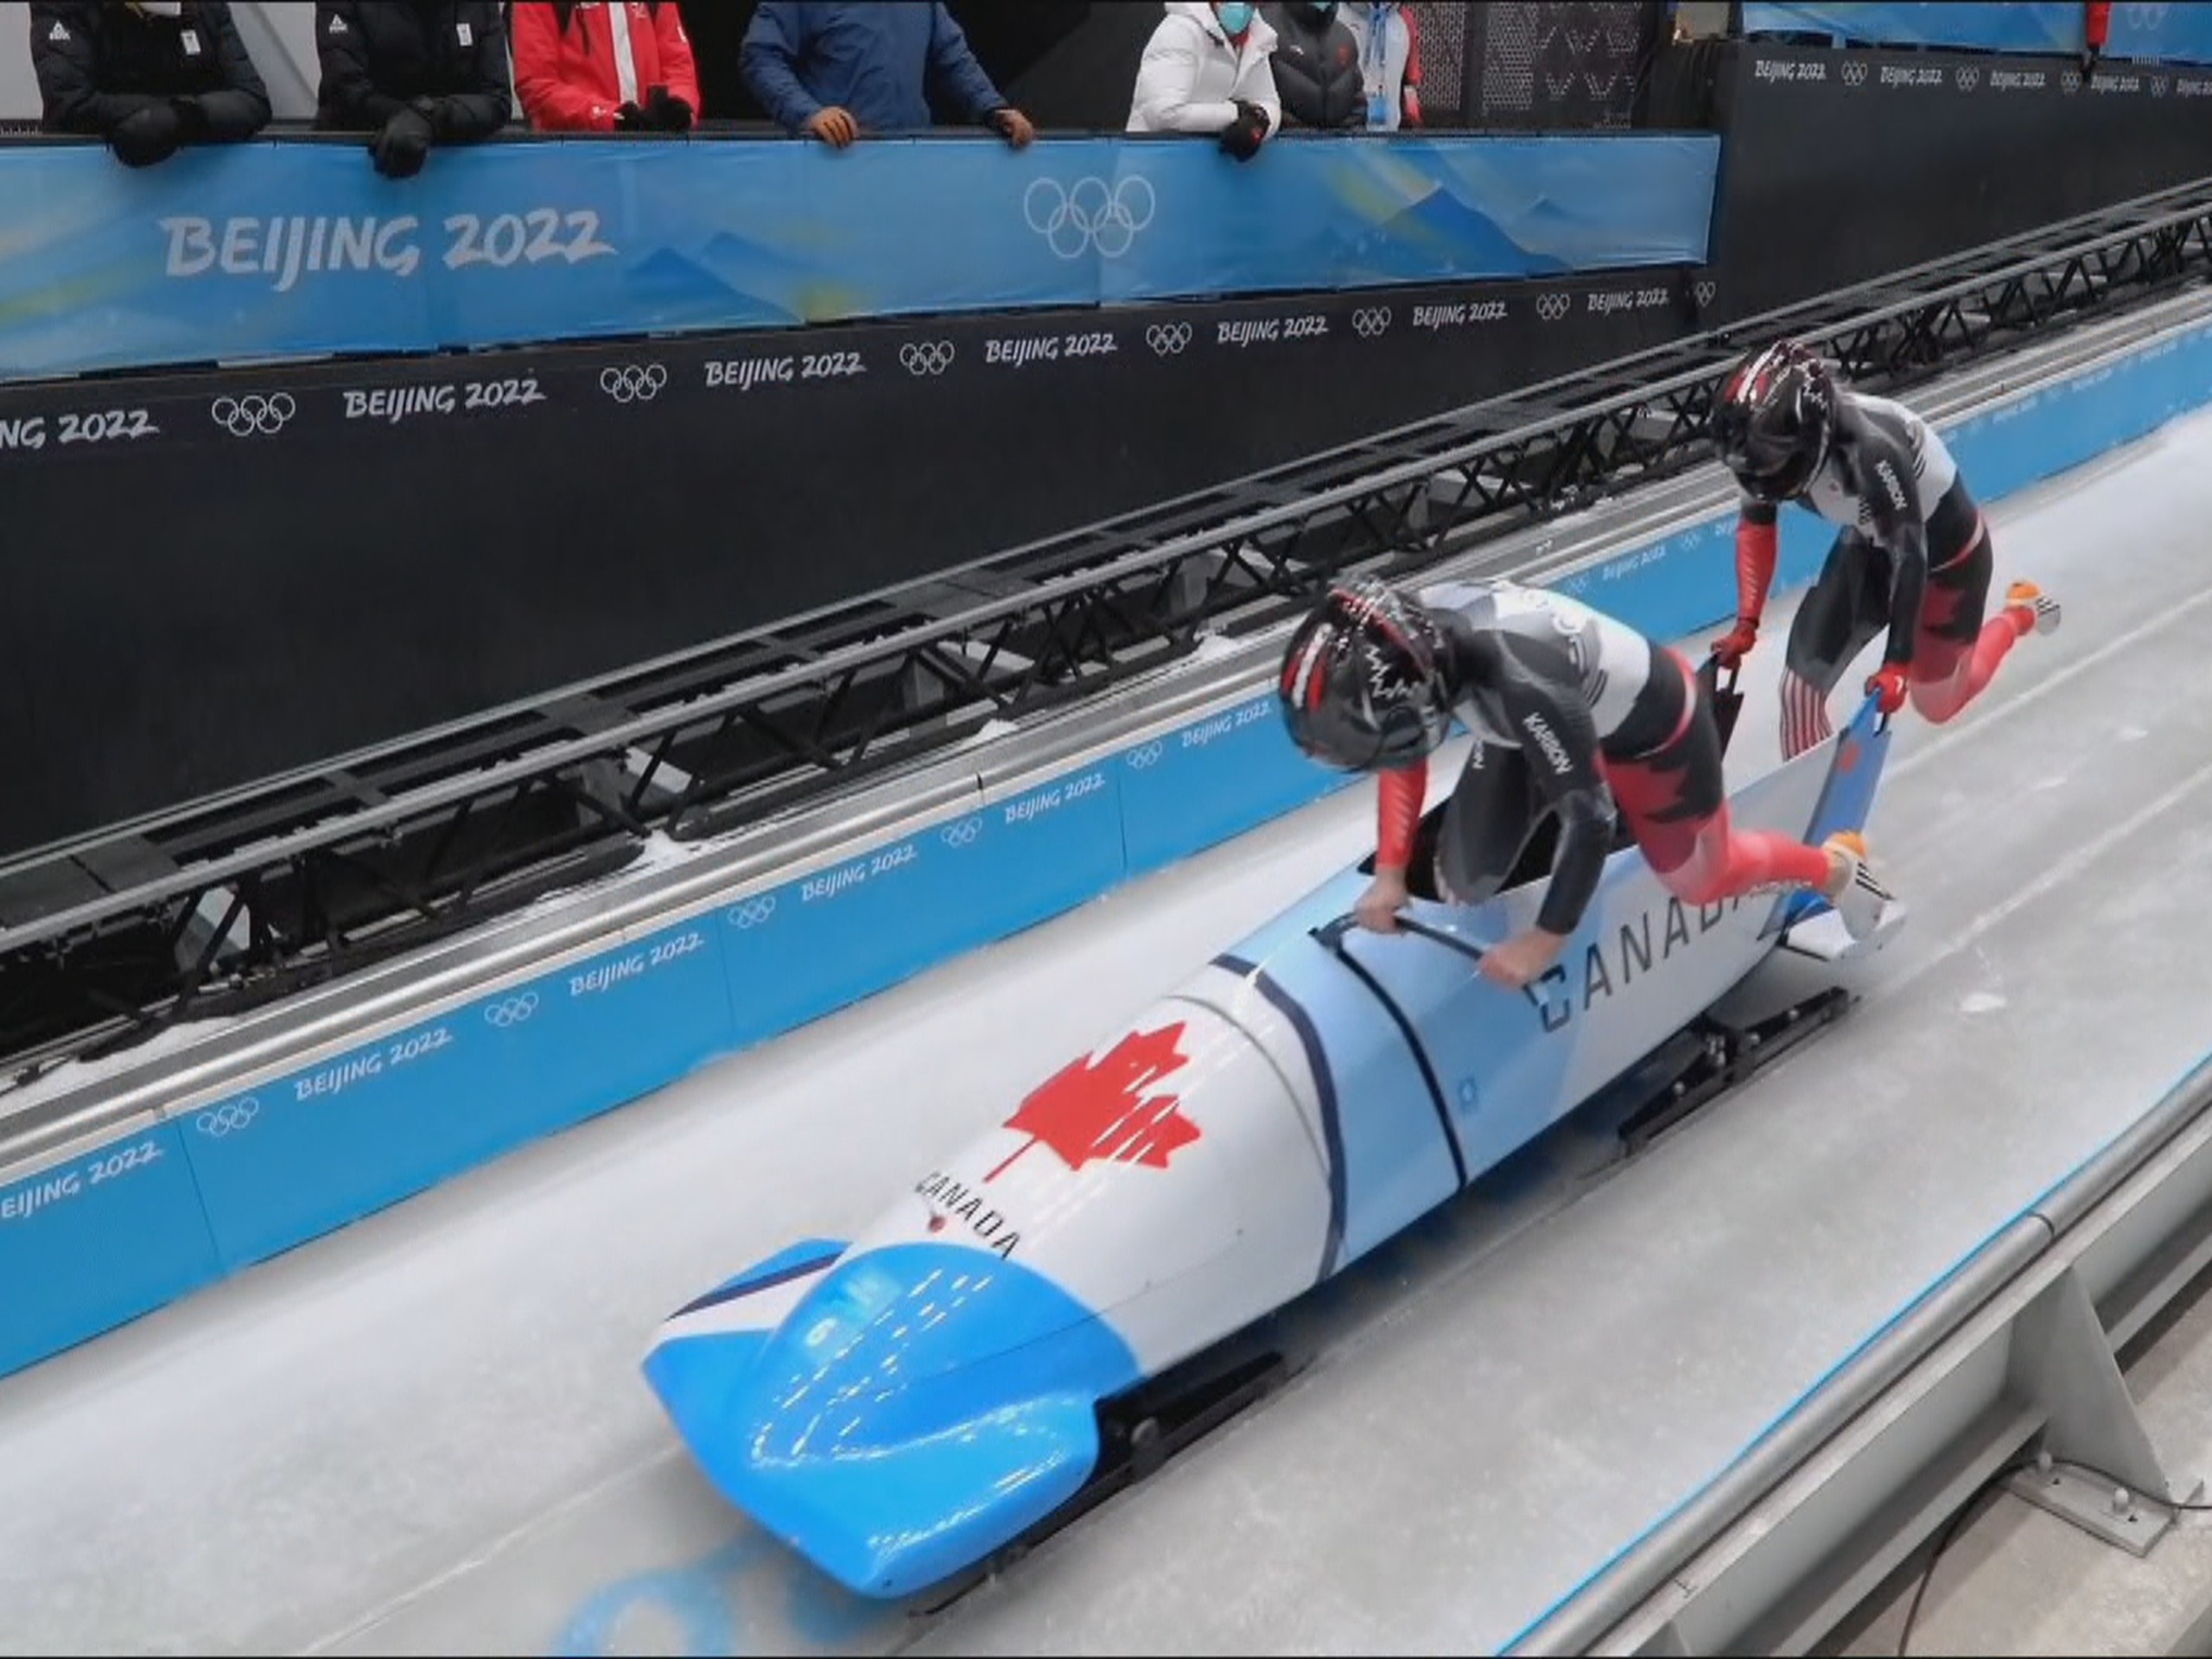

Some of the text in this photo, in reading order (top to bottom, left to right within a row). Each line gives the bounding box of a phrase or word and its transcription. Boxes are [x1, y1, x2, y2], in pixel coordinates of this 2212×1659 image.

[159, 207, 619, 292] BEIJING 2022
[1413, 302, 1508, 329] BEIJING 2022
[1588, 288, 1669, 313] BEIJING 2022
[986, 333, 1117, 365] BEIJING 2022
[1218, 315, 1329, 346] BEIJING 2022
[704, 352, 866, 391] BEIJING 2022
[343, 378, 546, 423] BEIJING 2022
[58, 410, 161, 443] 2022
[1182, 700, 1273, 747] BEIJING 2022
[1005, 772, 1106, 824] BEIJING 2022
[801, 844, 918, 901] BEIJING 2022
[569, 931, 705, 996] BEIJING 2022
[294, 1027, 454, 1101] BEIJING 2022
[87, 1140, 165, 1185] 2022
[916, 1171, 1020, 1261] CANADA
